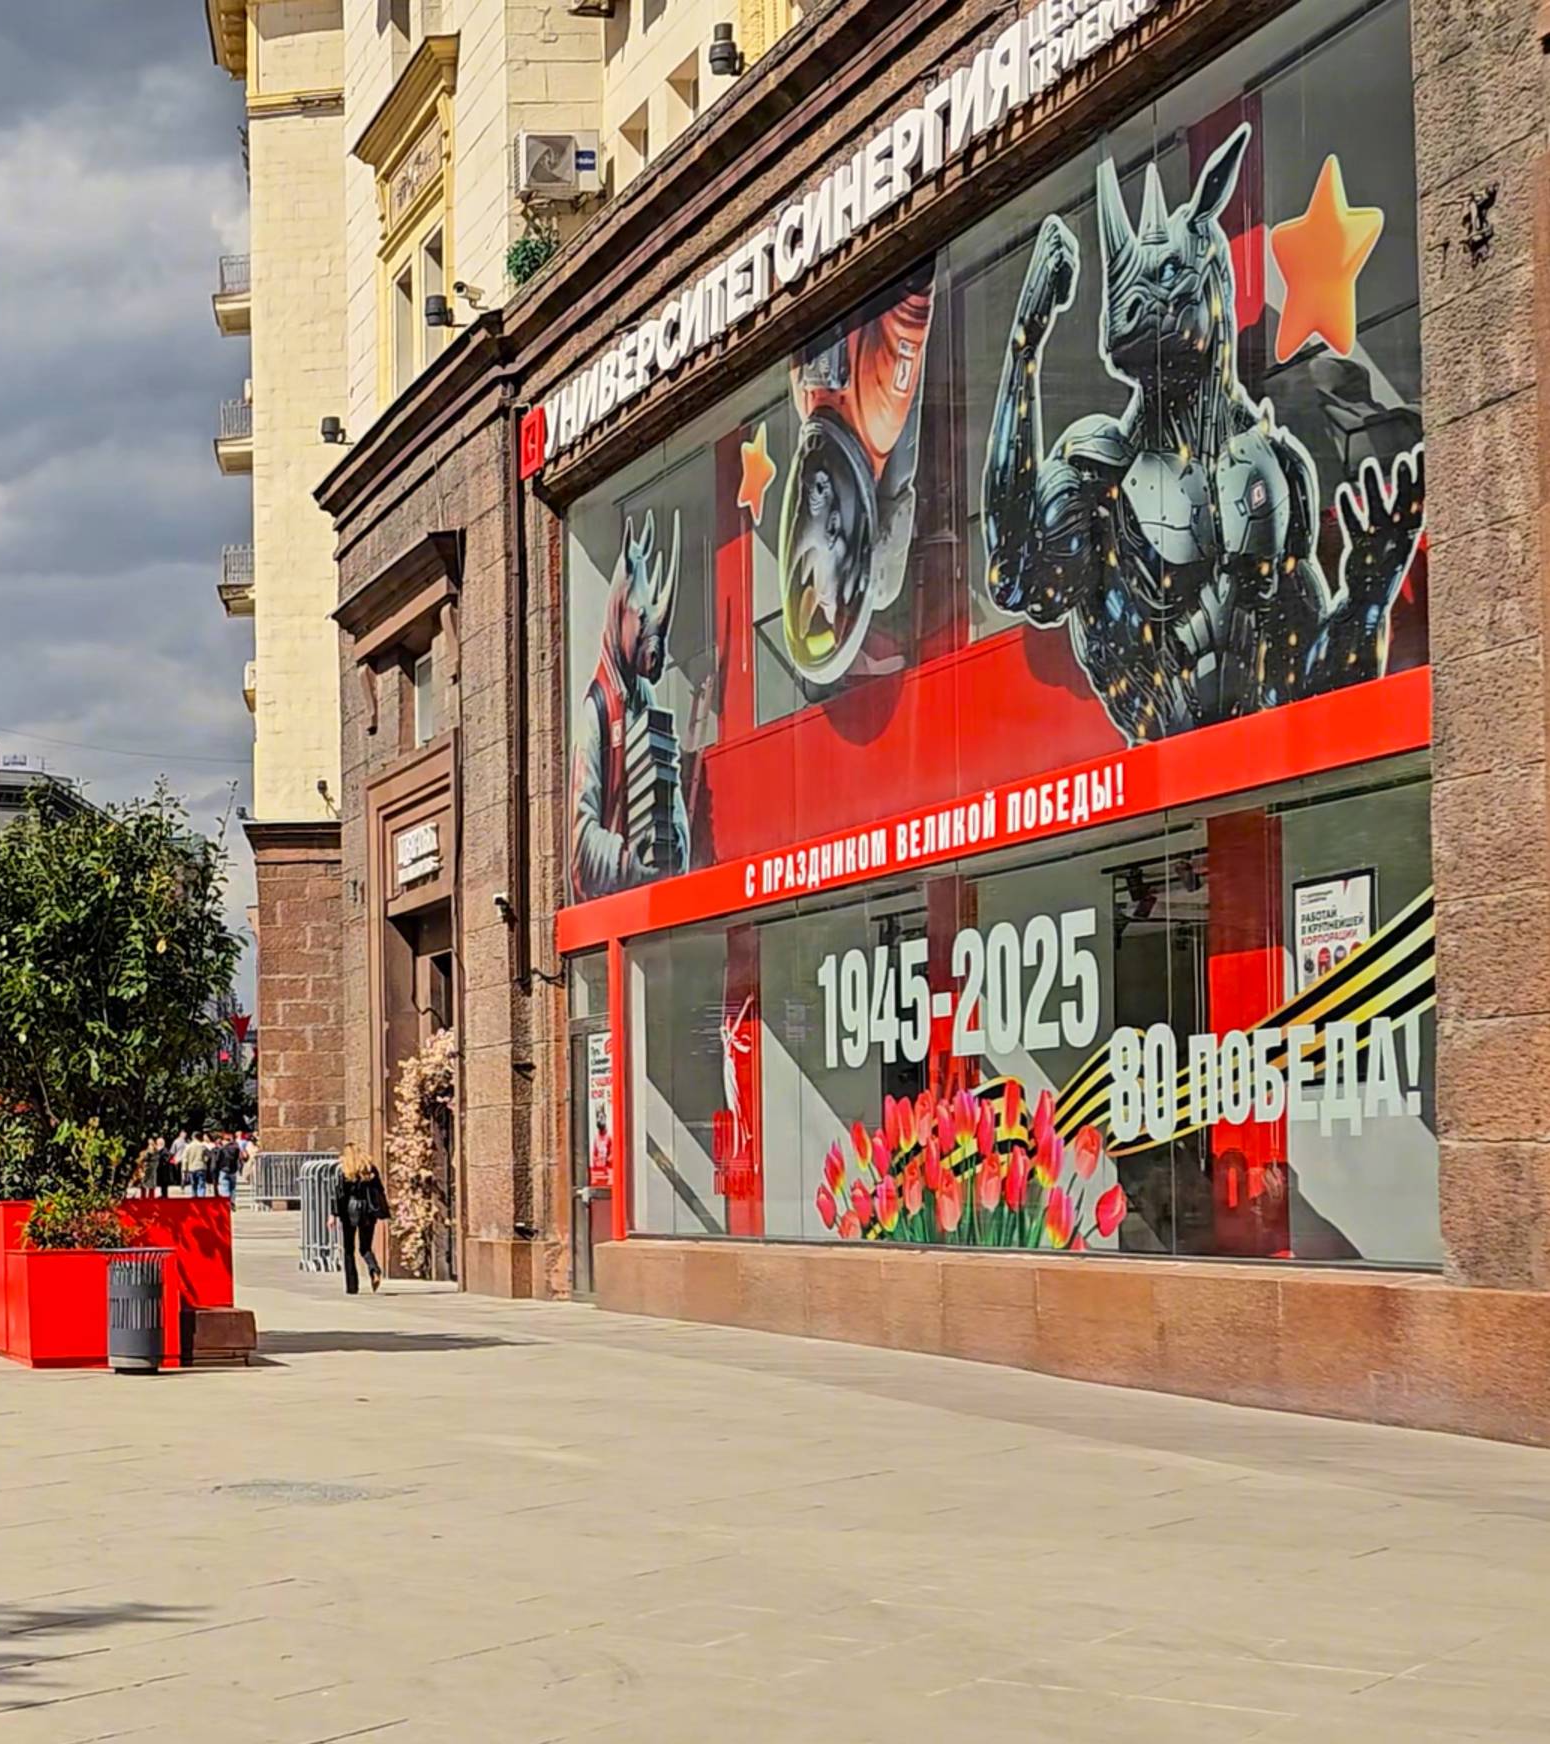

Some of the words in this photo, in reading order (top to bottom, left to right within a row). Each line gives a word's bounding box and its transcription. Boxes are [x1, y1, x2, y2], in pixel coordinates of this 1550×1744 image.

[544, 226, 772, 460] УНИВЕРСИТЕТ
[774, 18, 1030, 284] СИНЕРГИЯ
[745, 863, 755, 898] С
[762, 828, 887, 894] ПРАЗДНИКОМ
[896, 791, 996, 861] ВЕЛИКОЙ
[1006, 762, 1124, 833] ПОБЕДЫ!
[818, 907, 1099, 1069] 1945-2025
[1110, 1022, 1177, 1143] 80
[1189, 1013, 1422, 1137] ПОБЕДА!
